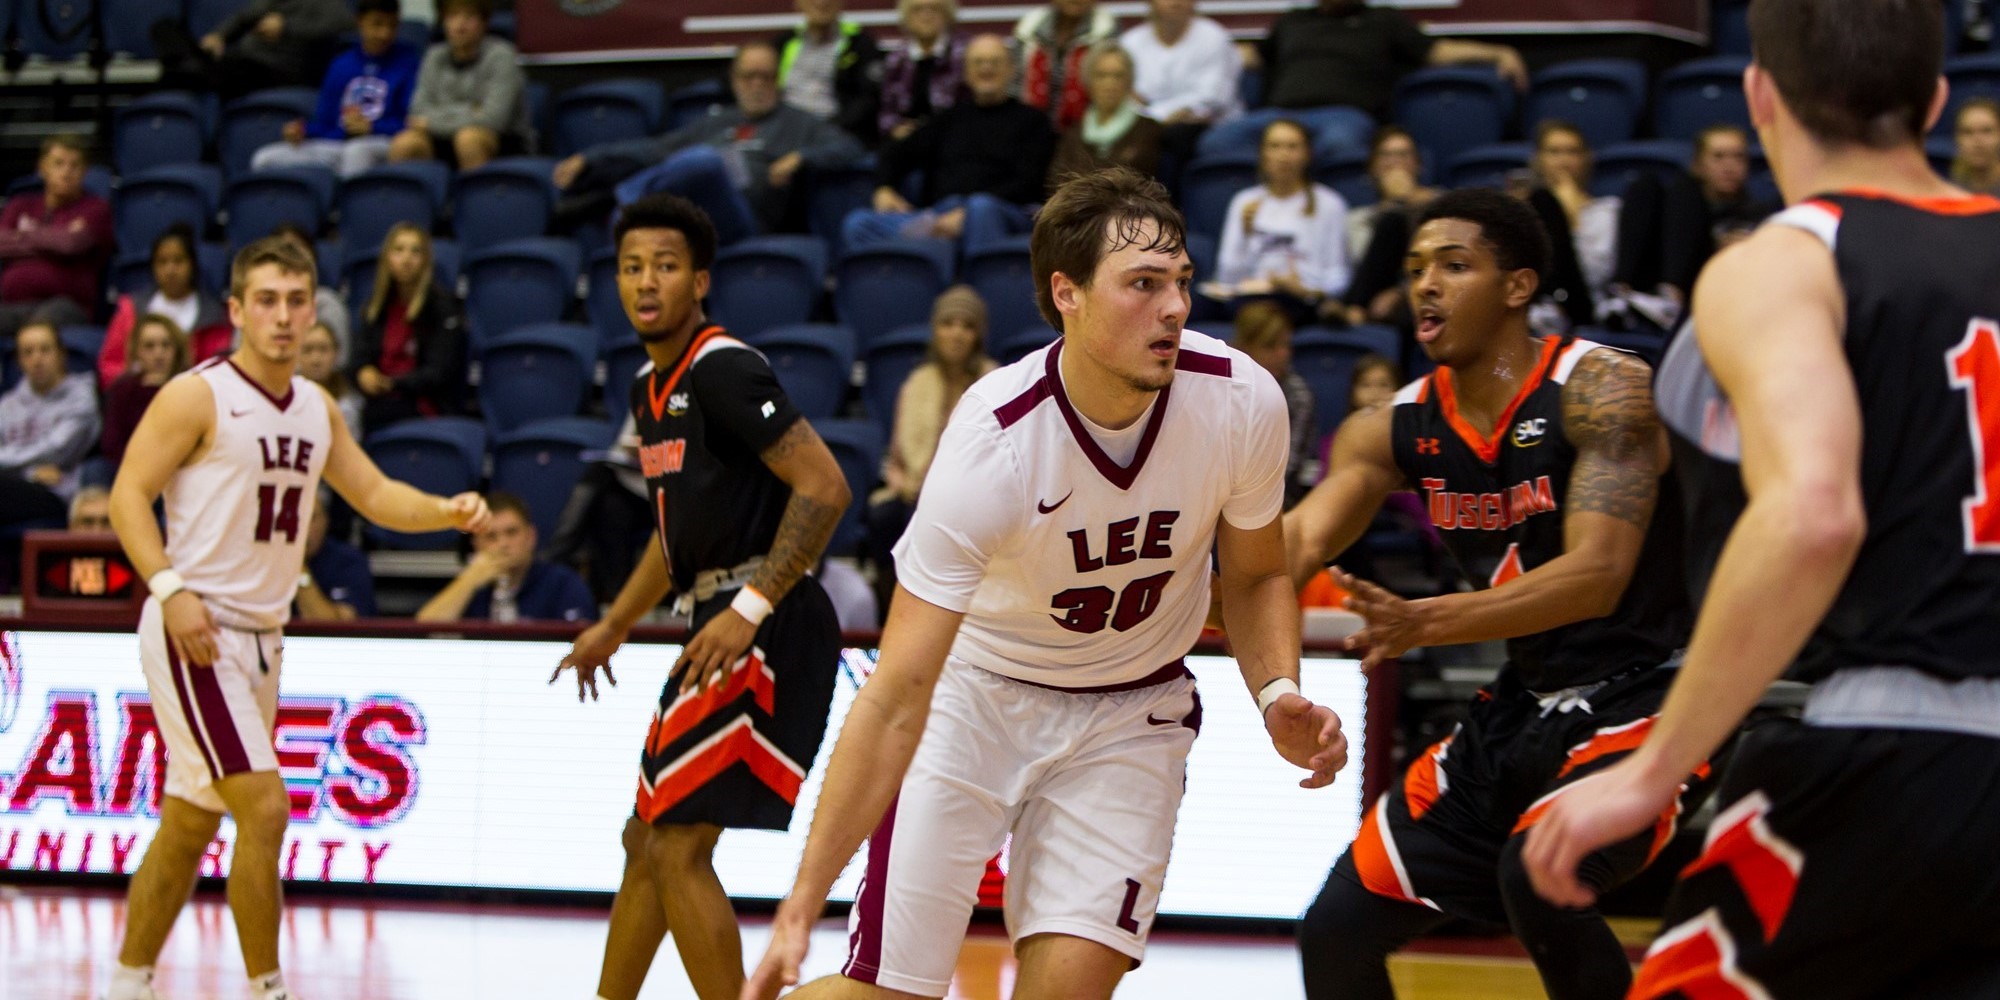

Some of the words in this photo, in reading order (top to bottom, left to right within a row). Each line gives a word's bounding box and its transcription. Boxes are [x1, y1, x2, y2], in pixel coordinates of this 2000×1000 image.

[257, 435, 314, 475] LEE
[1516, 418, 1548, 441] SAC
[254, 484, 303, 543] 14
[1067, 510, 1180, 573] LEE
[1049, 570, 1176, 634] 30
[1116, 878, 1141, 935] L
